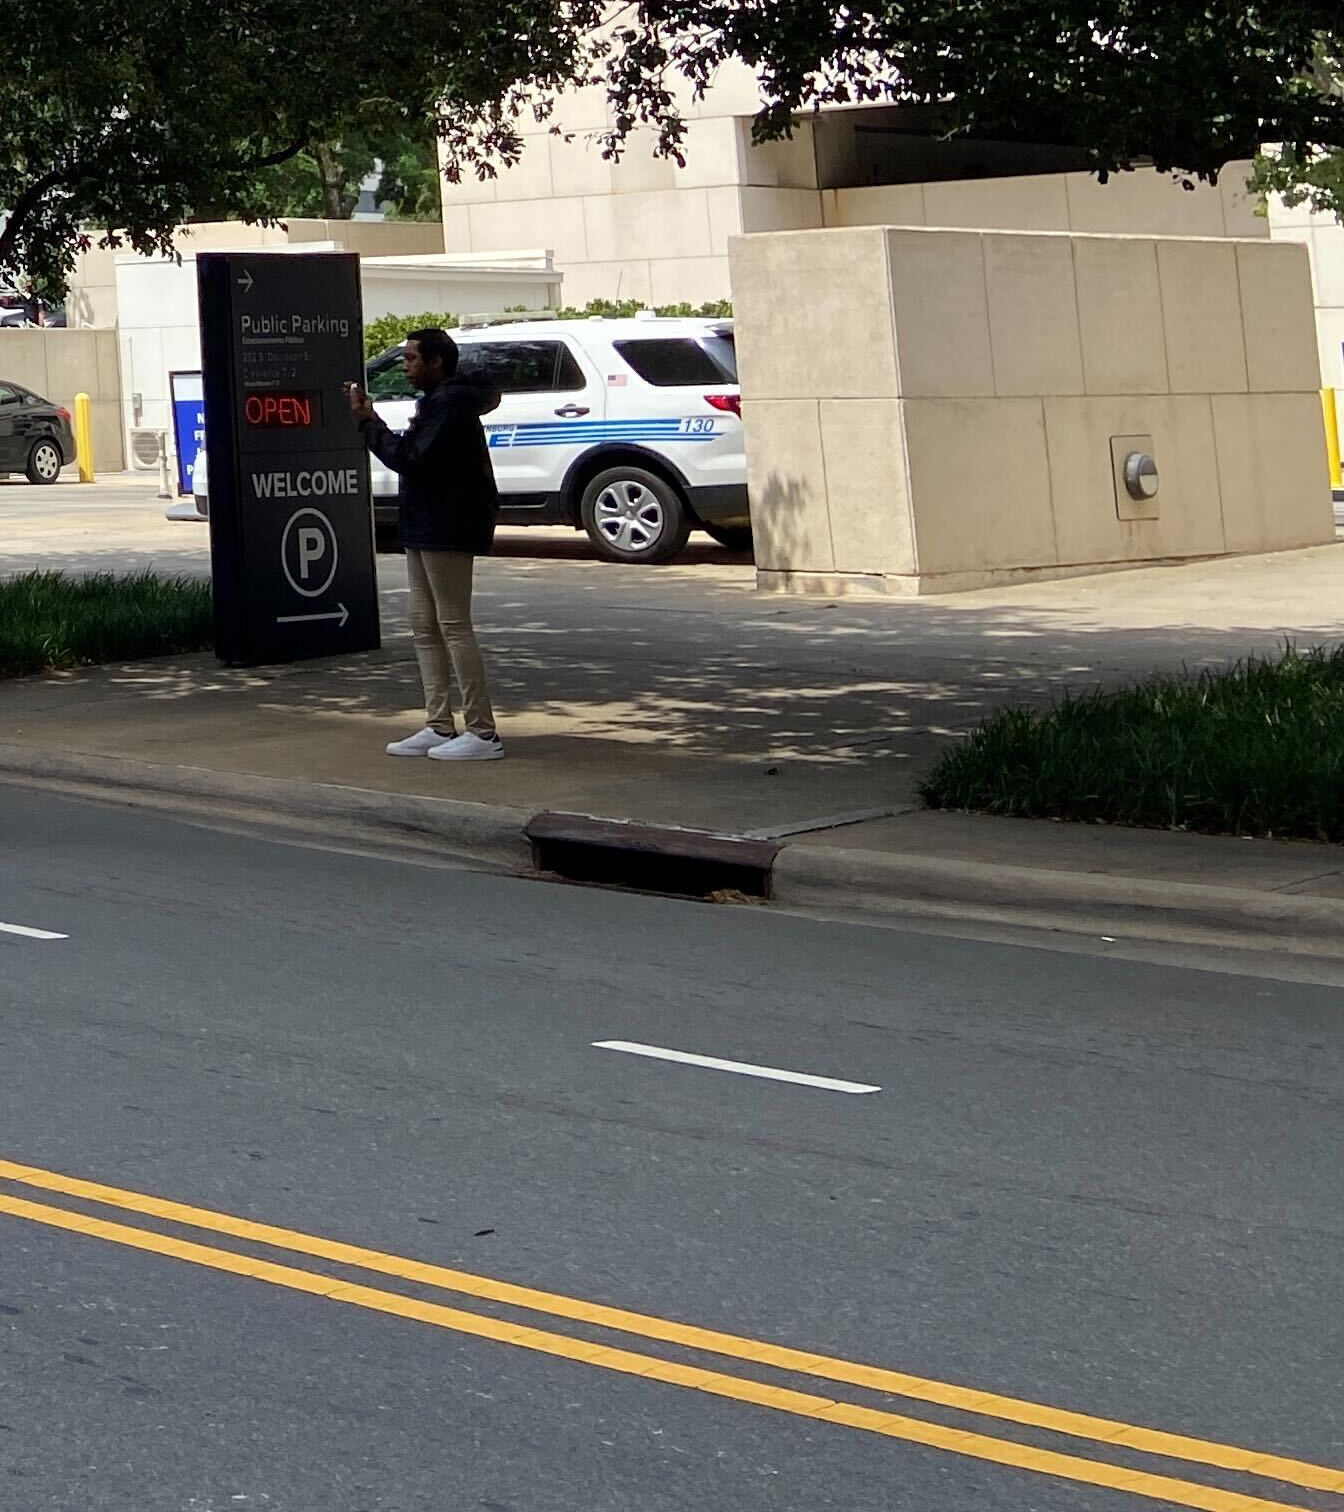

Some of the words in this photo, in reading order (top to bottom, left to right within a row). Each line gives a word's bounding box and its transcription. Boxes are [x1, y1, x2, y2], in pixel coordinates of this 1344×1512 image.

[241, 314, 288, 334] Public
[291, 314, 349, 338] Parking
[245, 396, 311, 425] OPEN
[684, 418, 715, 433] 130
[252, 469, 359, 498] WELCOME
